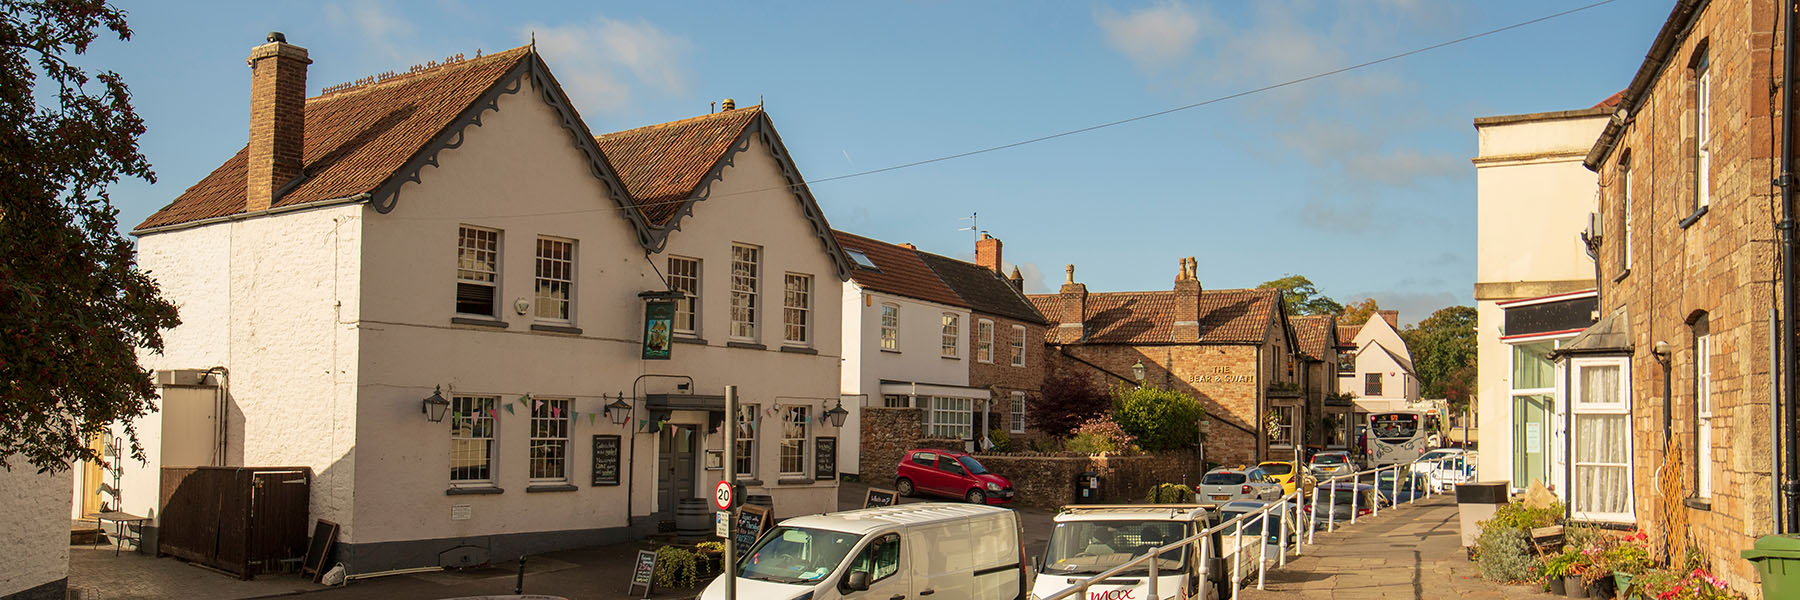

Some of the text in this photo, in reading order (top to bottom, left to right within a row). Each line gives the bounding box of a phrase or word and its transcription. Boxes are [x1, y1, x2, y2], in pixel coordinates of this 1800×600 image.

[1212, 366, 1231, 374] THE
[1189, 375, 1254, 383] BEAR & SWAN
[718, 489, 730, 502] 20
[1091, 588, 1136, 600] max
